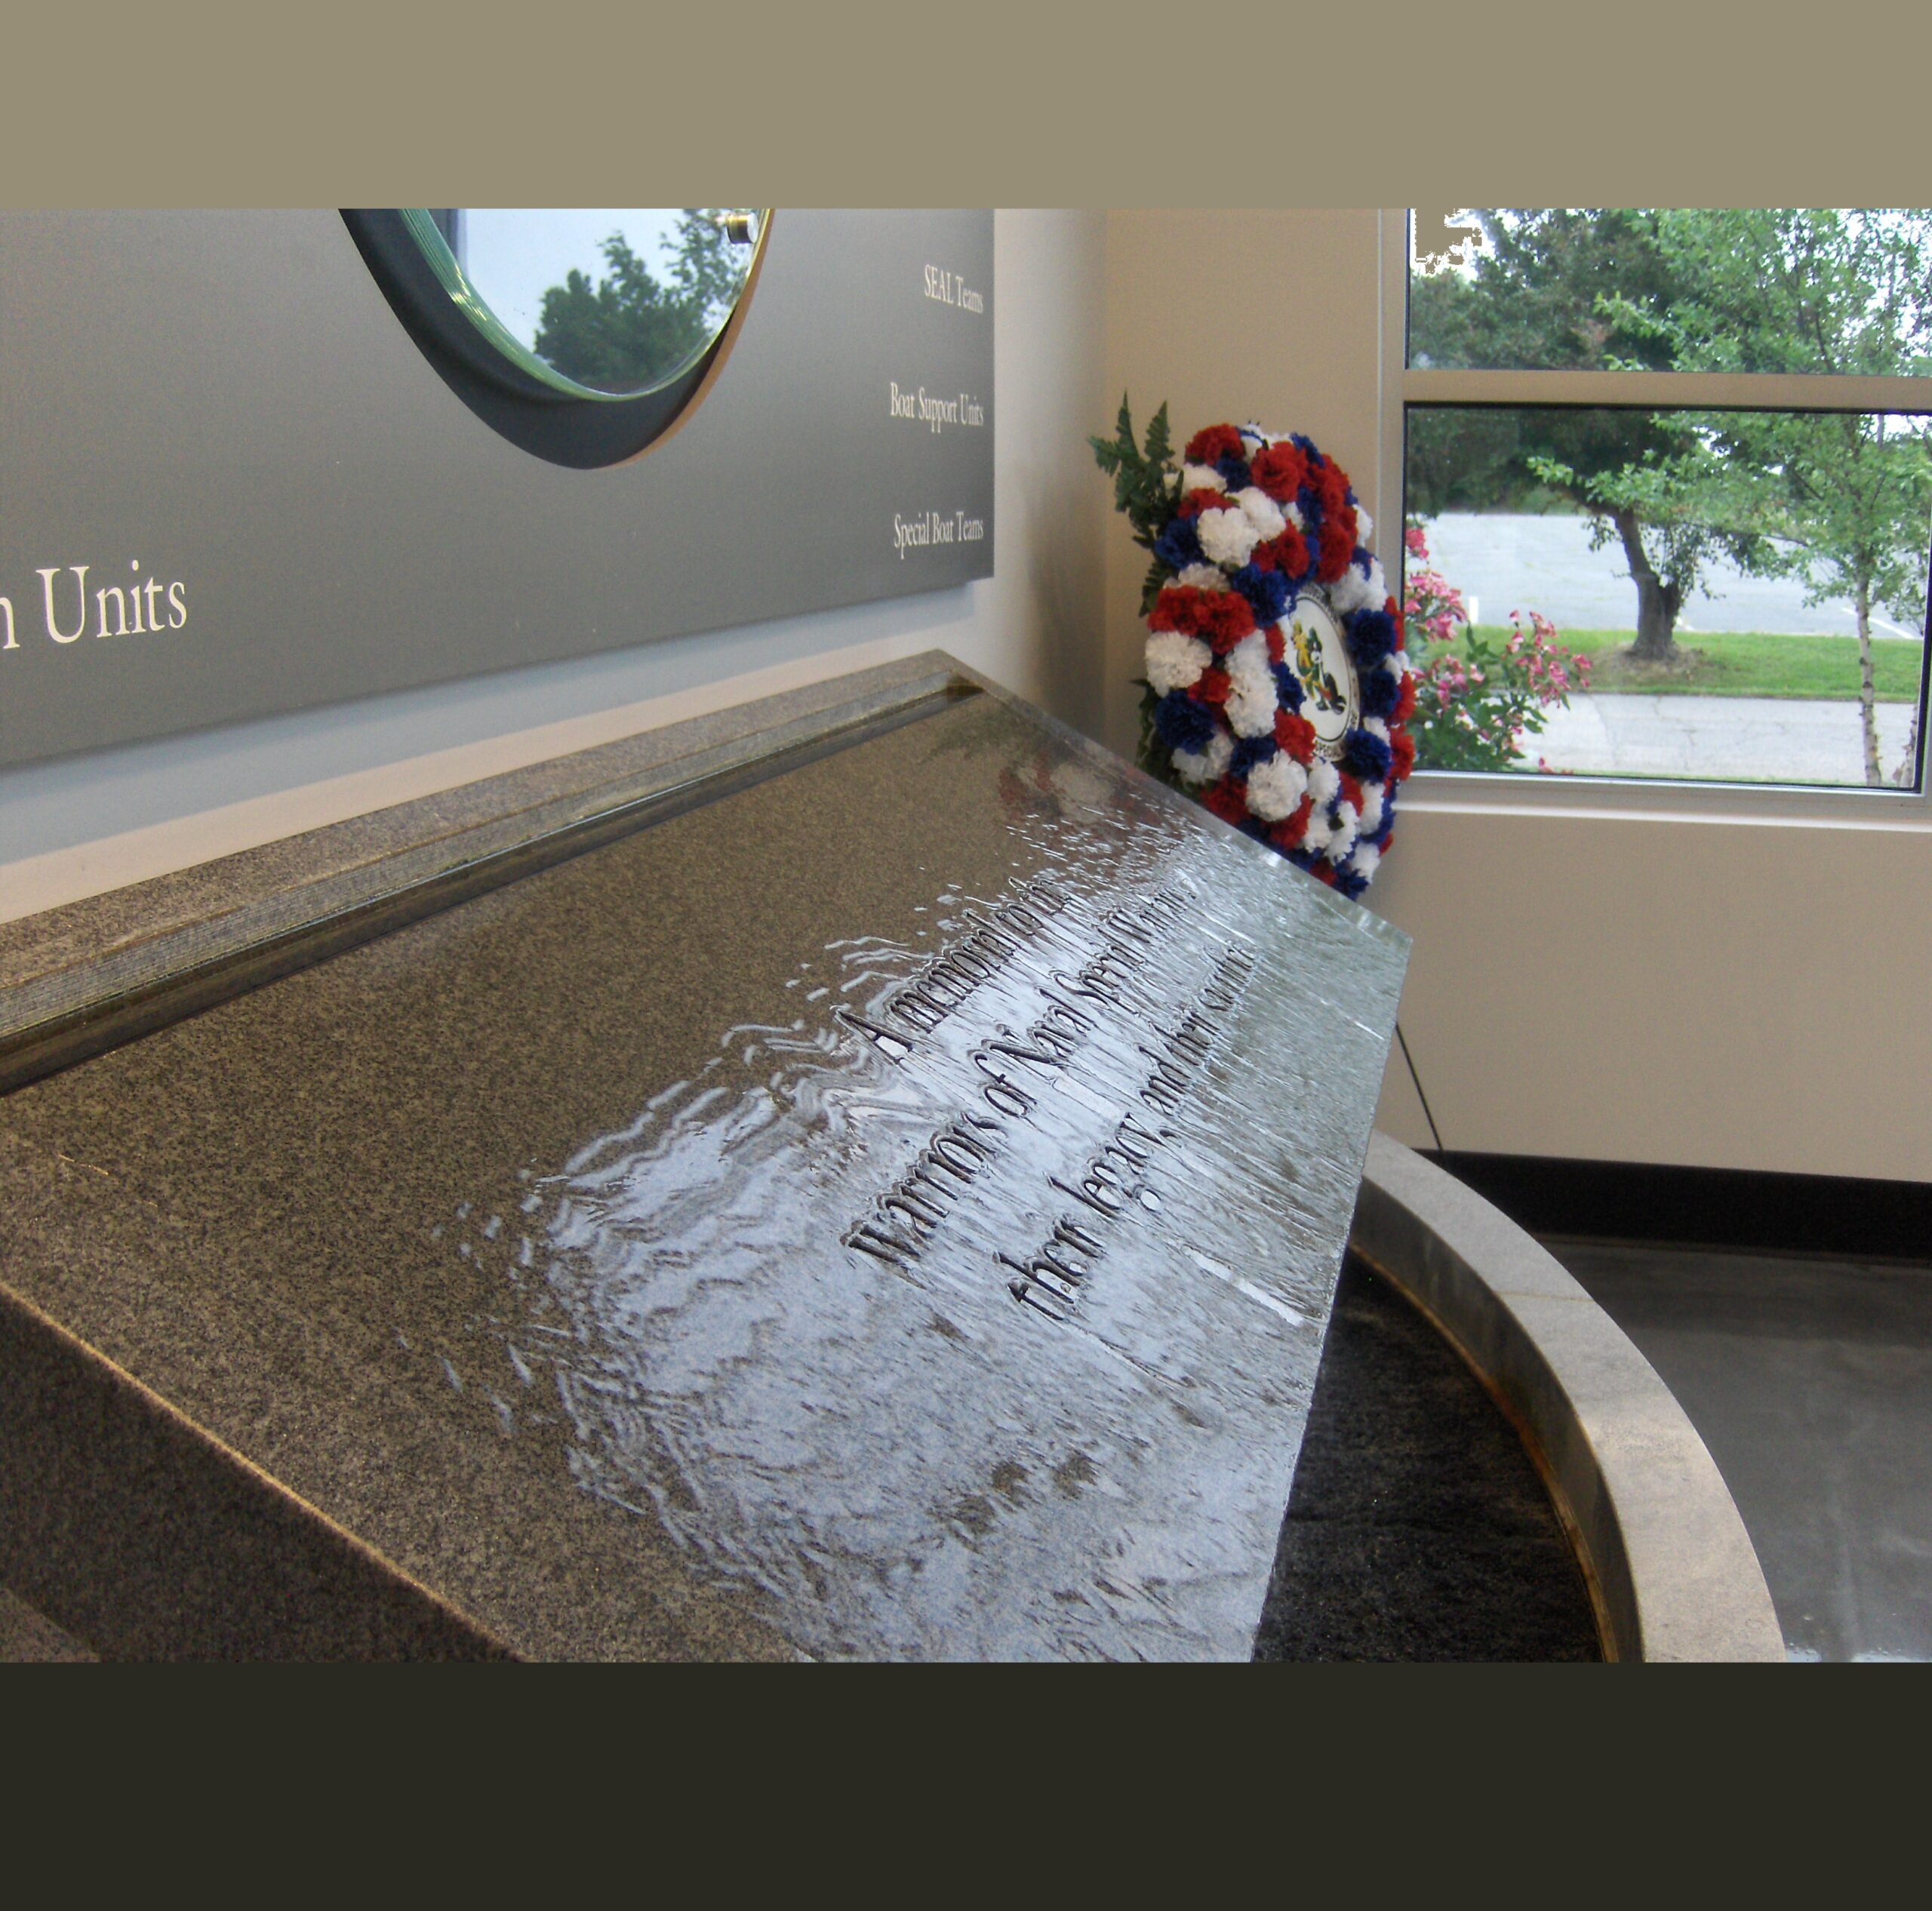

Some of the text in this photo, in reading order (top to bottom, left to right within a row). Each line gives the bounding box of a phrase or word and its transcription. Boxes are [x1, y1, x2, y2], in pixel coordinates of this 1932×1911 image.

[924, 264, 983, 314] SEAL Teams
[891, 382, 984, 433] Boat Support Units
[894, 511, 984, 560] Special Boat Teams
[35, 559, 187, 643] Units
[1051, 925, 1146, 1017] Special
[832, 1007, 915, 1066] A
[980, 986, 1094, 1076] Naval
[971, 1052, 1038, 1119] of
[840, 1113, 1008, 1271] Warriors
[996, 1218, 1105, 1321] their
[1138, 1045, 1192, 1119] and
